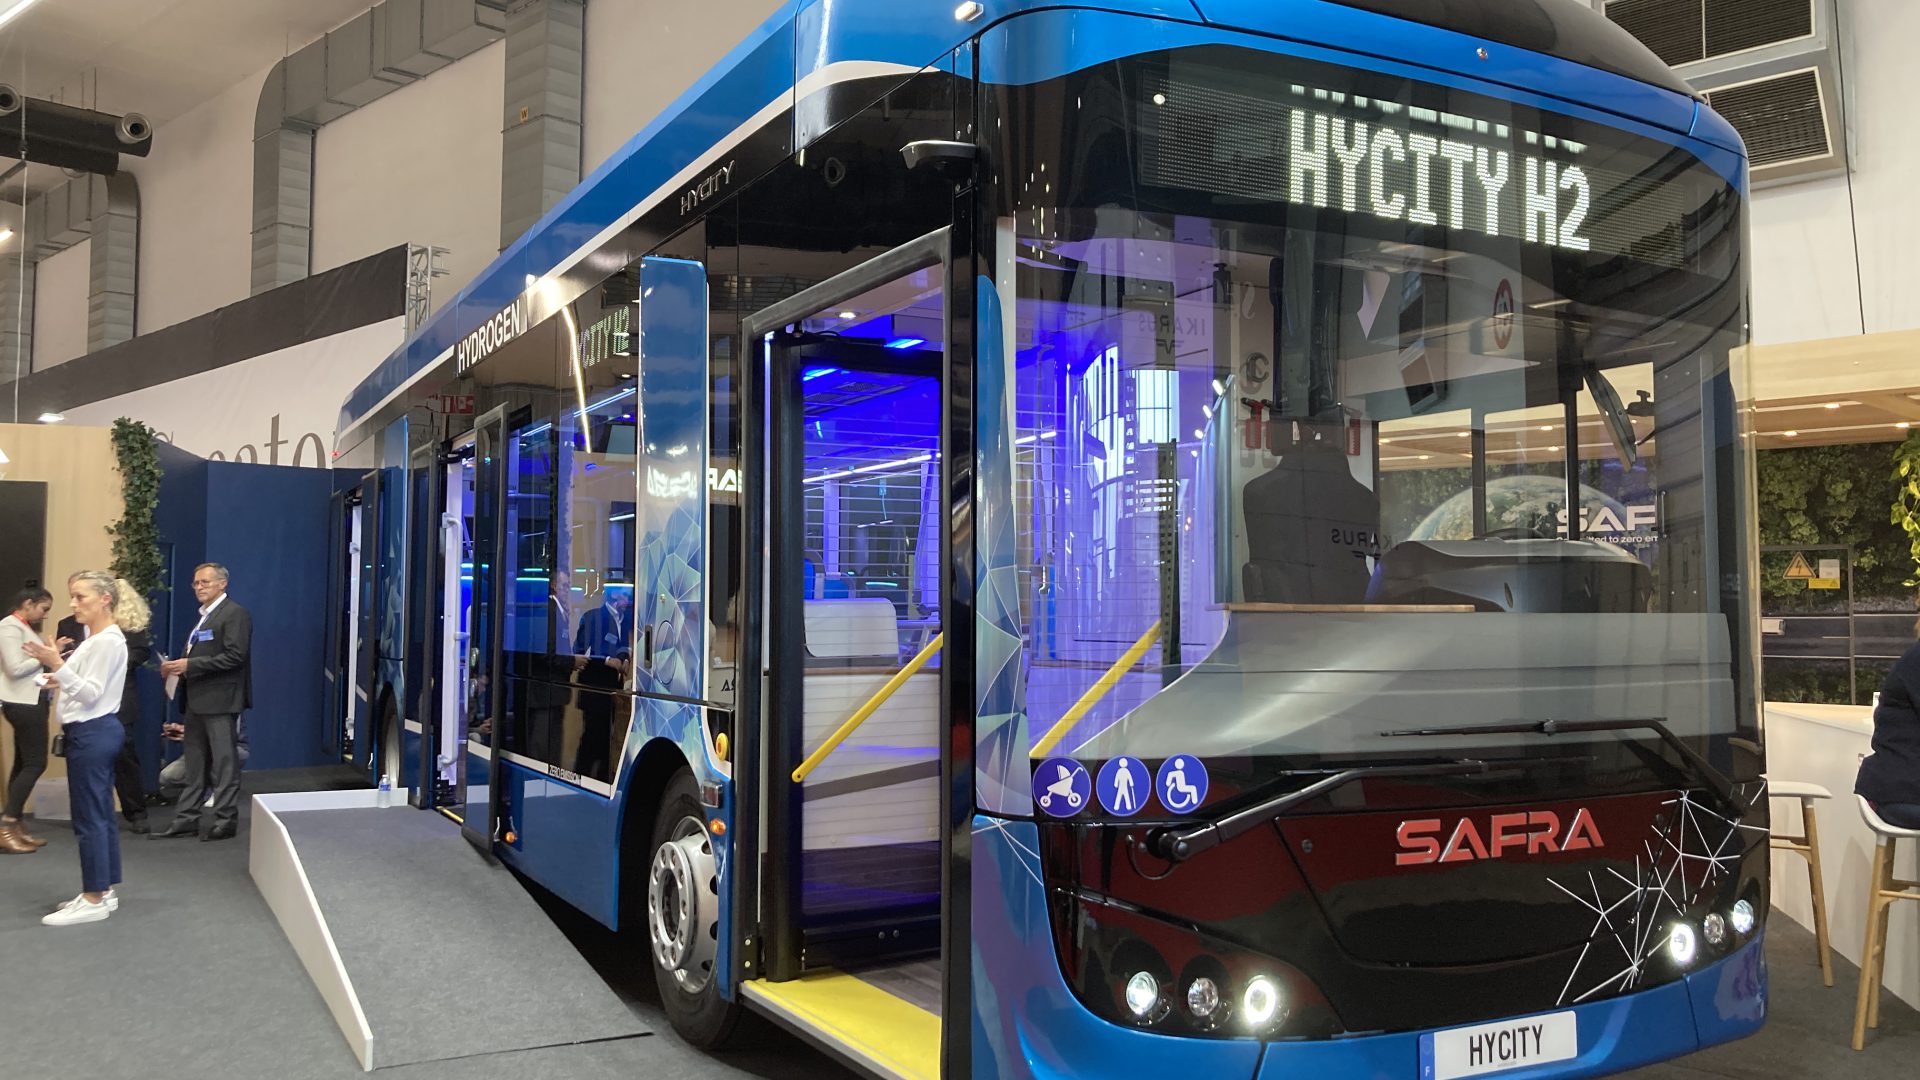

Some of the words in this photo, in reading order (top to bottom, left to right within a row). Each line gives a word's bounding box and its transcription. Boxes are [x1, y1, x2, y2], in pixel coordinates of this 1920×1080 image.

[680, 159, 735, 216] HYCITY
[1290, 109, 1509, 236] HYCITY
[1525, 155, 1590, 251] H2
[457, 298, 520, 374] HYDROGEN
[1621, 535, 1643, 543] zero
[1395, 807, 1605, 866] SAFRA
[1468, 1023, 1543, 1067] HYCITY
